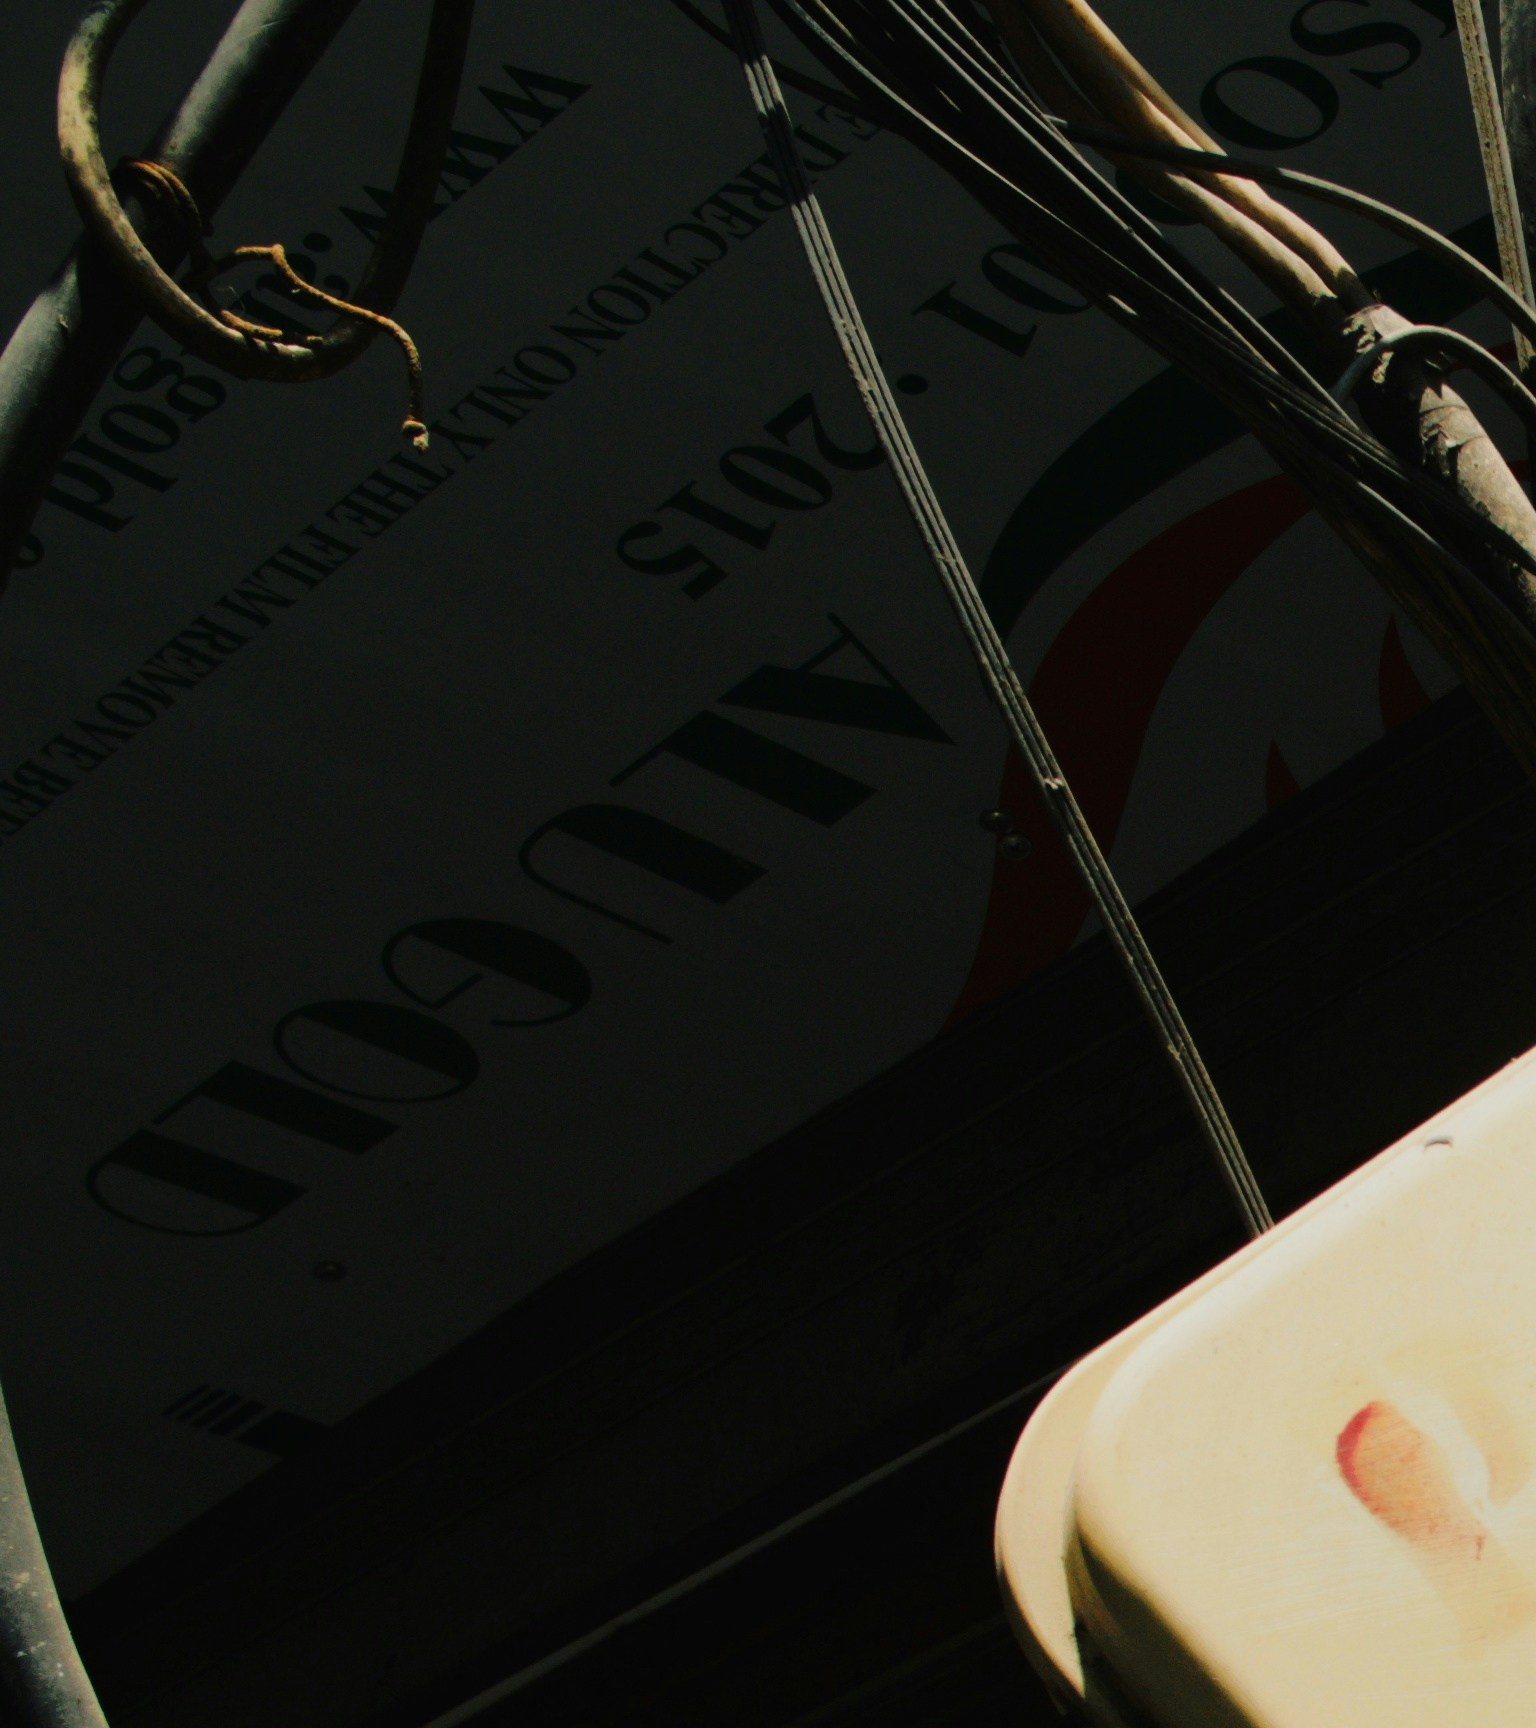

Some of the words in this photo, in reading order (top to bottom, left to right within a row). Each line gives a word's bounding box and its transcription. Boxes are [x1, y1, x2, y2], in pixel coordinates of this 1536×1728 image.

[1200, 0, 1455, 151] SO
[430, 344, 578, 462] ONLY
[326, 450, 455, 541] THE
[615, 392, 886, 600] 2015
[216, 518, 363, 629] FILM
[43, 614, 251, 792] REMOVE
[86, 613, 957, 1237] ALUGOLD
